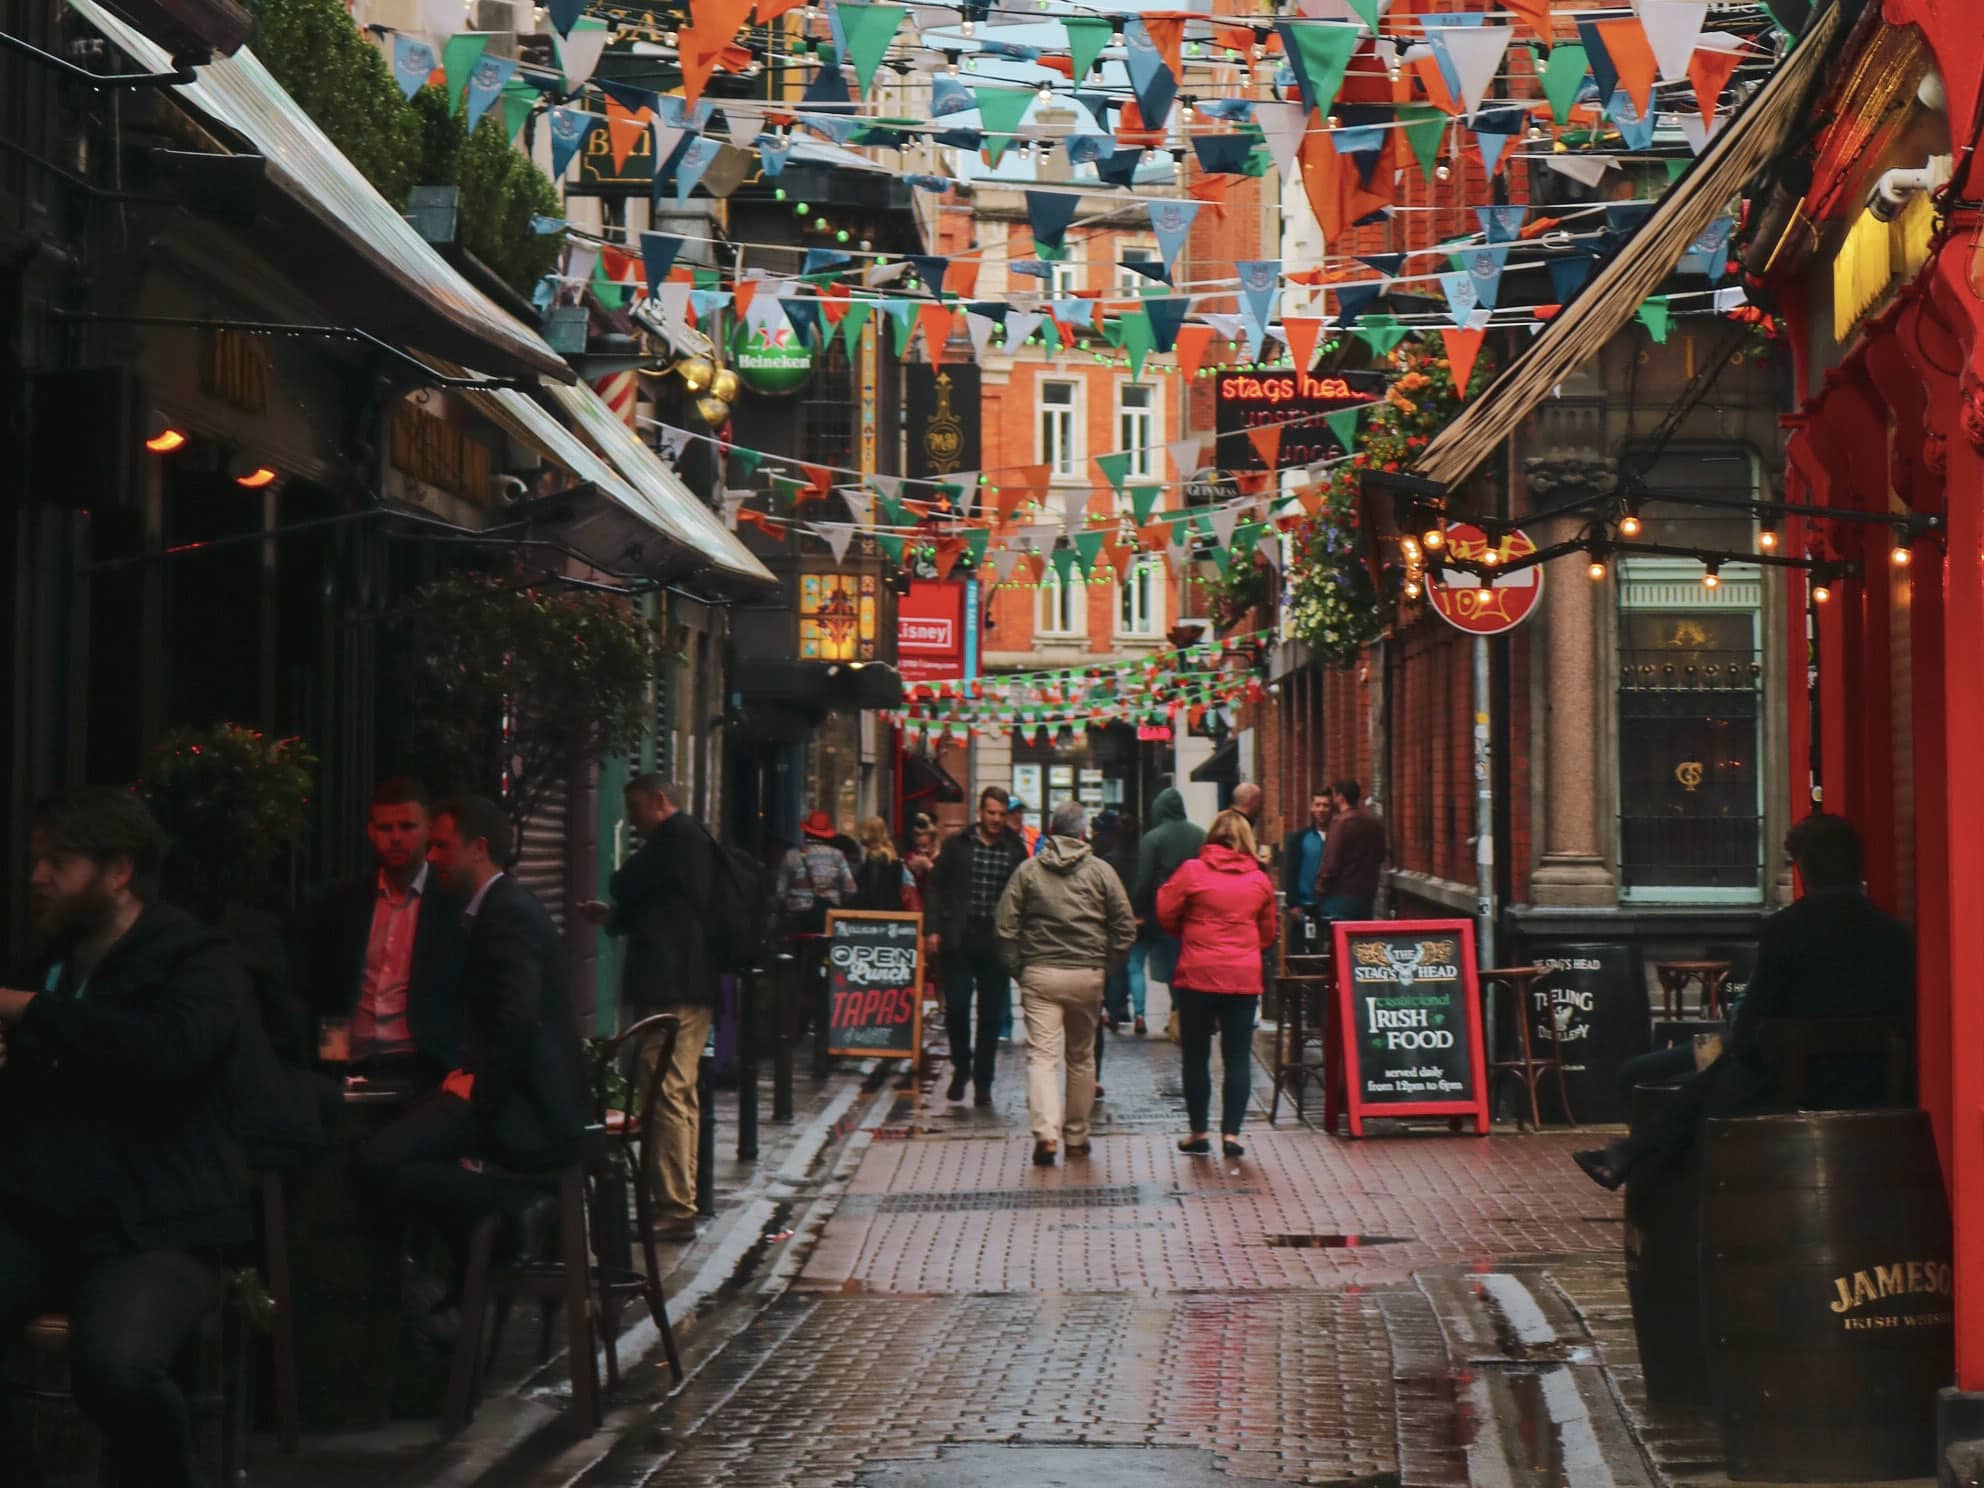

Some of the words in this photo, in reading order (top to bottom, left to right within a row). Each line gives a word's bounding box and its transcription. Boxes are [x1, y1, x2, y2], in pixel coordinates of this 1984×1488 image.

[739, 354, 811, 369] Heineken
[1222, 376, 1295, 402] stags
[1303, 374, 1364, 398] hea
[832, 945, 918, 968] OPEN
[1393, 949, 1417, 961] THE
[1418, 966, 1458, 978] HEAD
[831, 987, 917, 1029] TAPAS
[1365, 997, 1429, 1034] IRISH
[1386, 1030, 1455, 1050] FOOD
[1829, 1260, 1952, 1314] JAMESO
